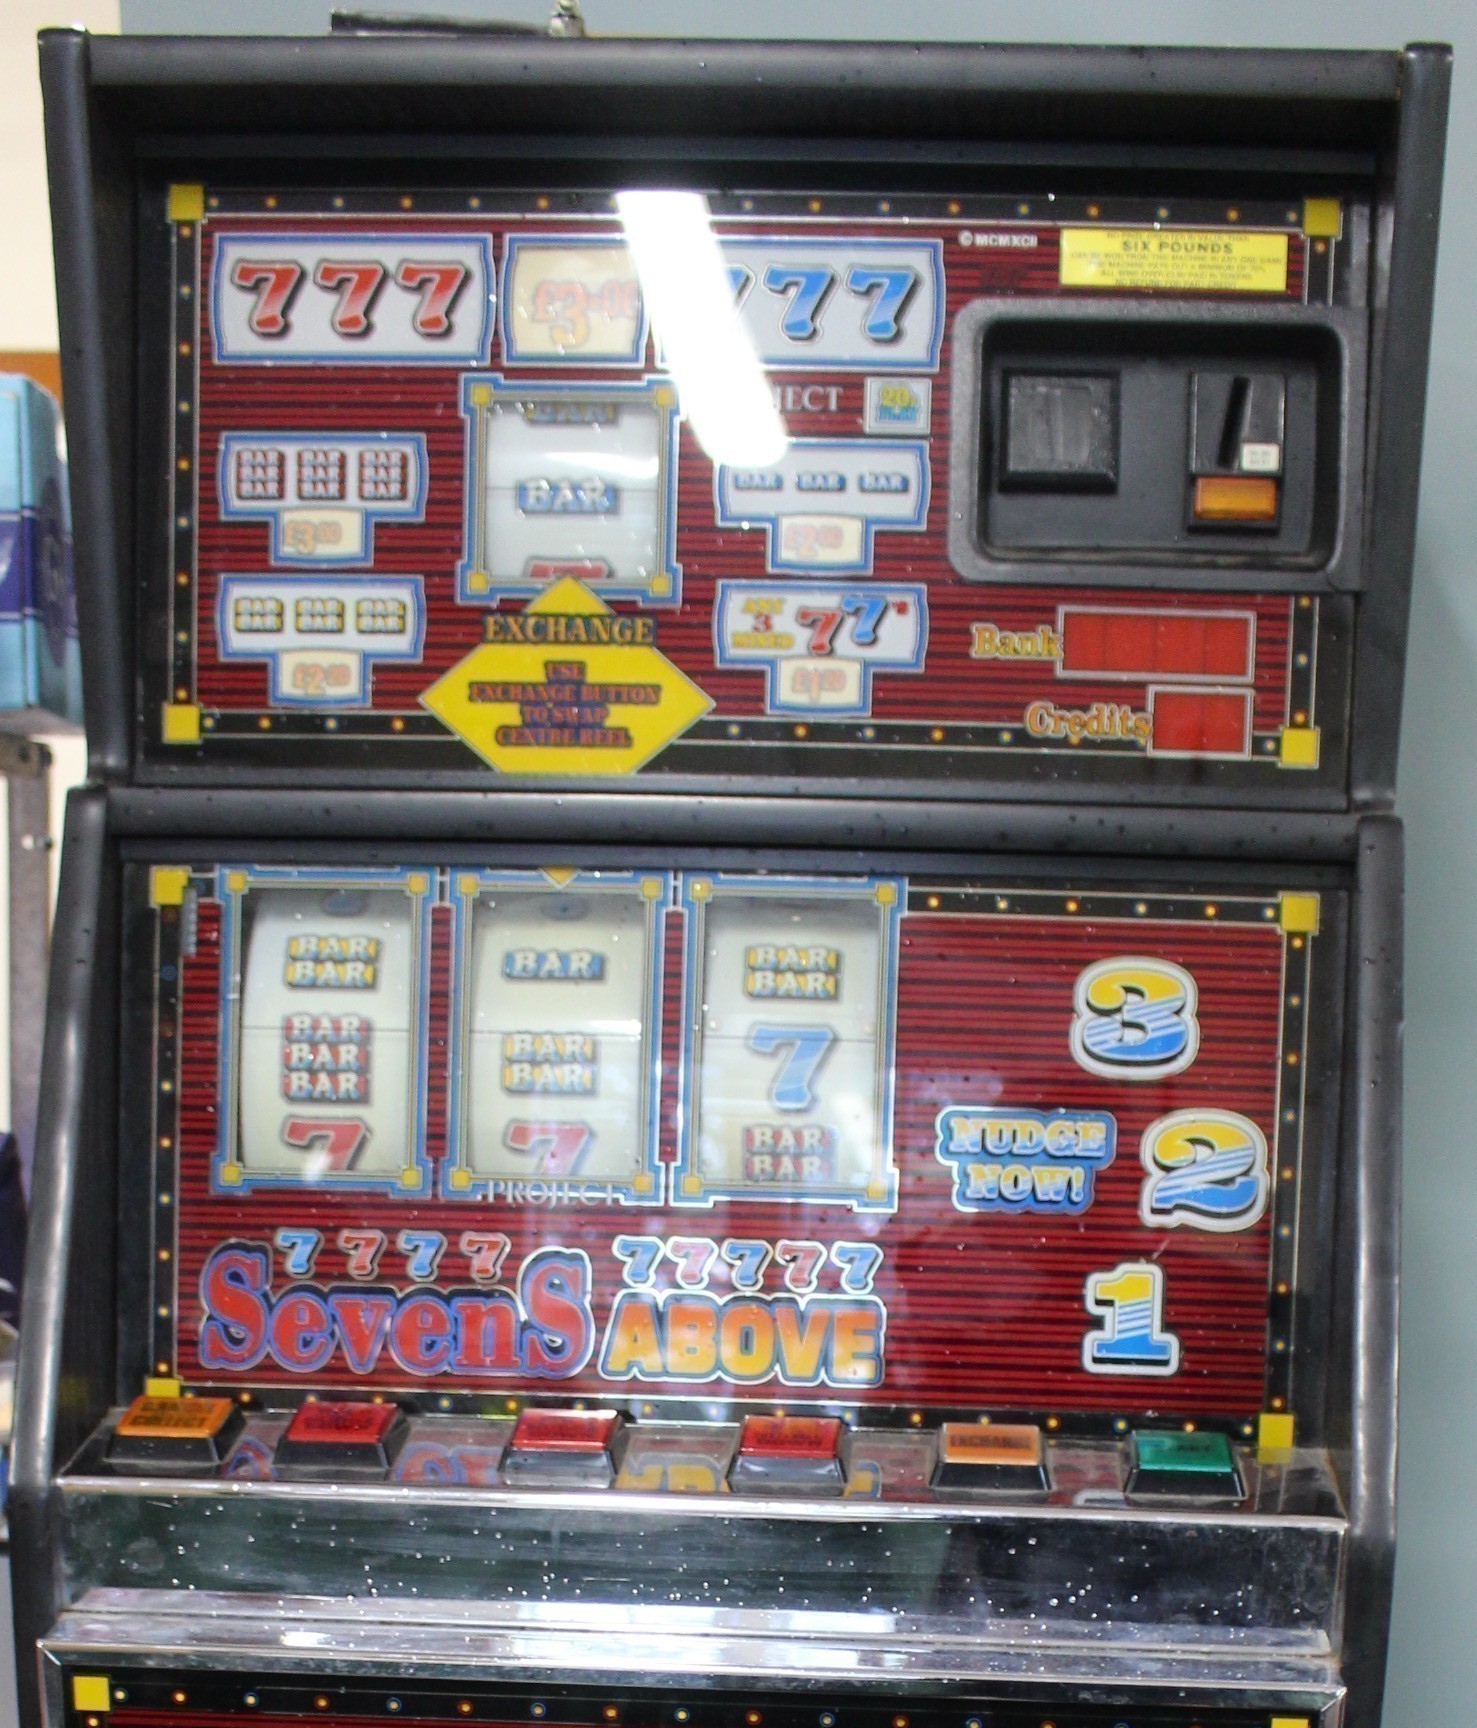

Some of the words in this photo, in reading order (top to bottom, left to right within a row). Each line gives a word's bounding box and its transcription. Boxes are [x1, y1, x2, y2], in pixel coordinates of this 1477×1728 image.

[1121, 240, 1150, 252] SIX
[1158, 241, 1233, 254] POUNDS
[240, 449, 280, 466] BAR
[300, 449, 340, 466] BAR
[362, 449, 402, 466] BAR
[240, 465, 280, 482] BAR
[300, 465, 340, 482] BAR
[362, 465, 402, 482] BAR
[240, 481, 280, 498] BAR
[300, 481, 340, 498] BAR
[362, 481, 402, 498] BAR
[525, 478, 608, 514] BAR
[238, 598, 278, 615] BAR
[298, 598, 339, 615] BAR
[360, 598, 400, 615] BAR
[741, 597, 784, 614] ANY
[238, 614, 278, 631] BAR
[298, 614, 339, 631] BAR
[360, 614, 400, 631] BAR
[484, 614, 656, 643] EXCHANGE
[752, 612, 773, 633] 3
[731, 631, 794, 650] MIXED
[972, 623, 1063, 658] Bank
[546, 662, 582, 681] USE
[470, 683, 577, 702] EXCHANGE
[579, 685, 661, 704] BUTTON
[522, 704, 548, 723] TO
[550, 705, 609, 725] SWAP
[1026, 700, 1152, 738] Credits
[496, 726, 576, 745] CENTRE
[298, 935, 371, 960] BAR
[755, 944, 829, 970] BAR
[294, 960, 367, 986] BAR
[513, 949, 594, 979] BAR
[753, 970, 828, 998] BAR
[292, 1013, 362, 1041] BAR
[1080, 966, 1190, 1065] 3
[289, 1042, 361, 1071] BAR
[511, 1033, 586, 1061] BAR
[510, 1062, 585, 1091] BAR
[748, 1024, 835, 1112] 7
[288, 1071, 361, 1100] BAR
[752, 1125, 824, 1153] BAR
[948, 1115, 1108, 1159] NUDGE
[750, 1153, 823, 1181] BAR
[1148, 1118, 1260, 1219] 2
[487, 1180, 616, 1209] PROJECT
[966, 1162, 1085, 1204] NOW!
[201, 1242, 592, 1378] SevenS
[602, 1295, 884, 1385] ABOVE
[1090, 1272, 1173, 1365] 1
